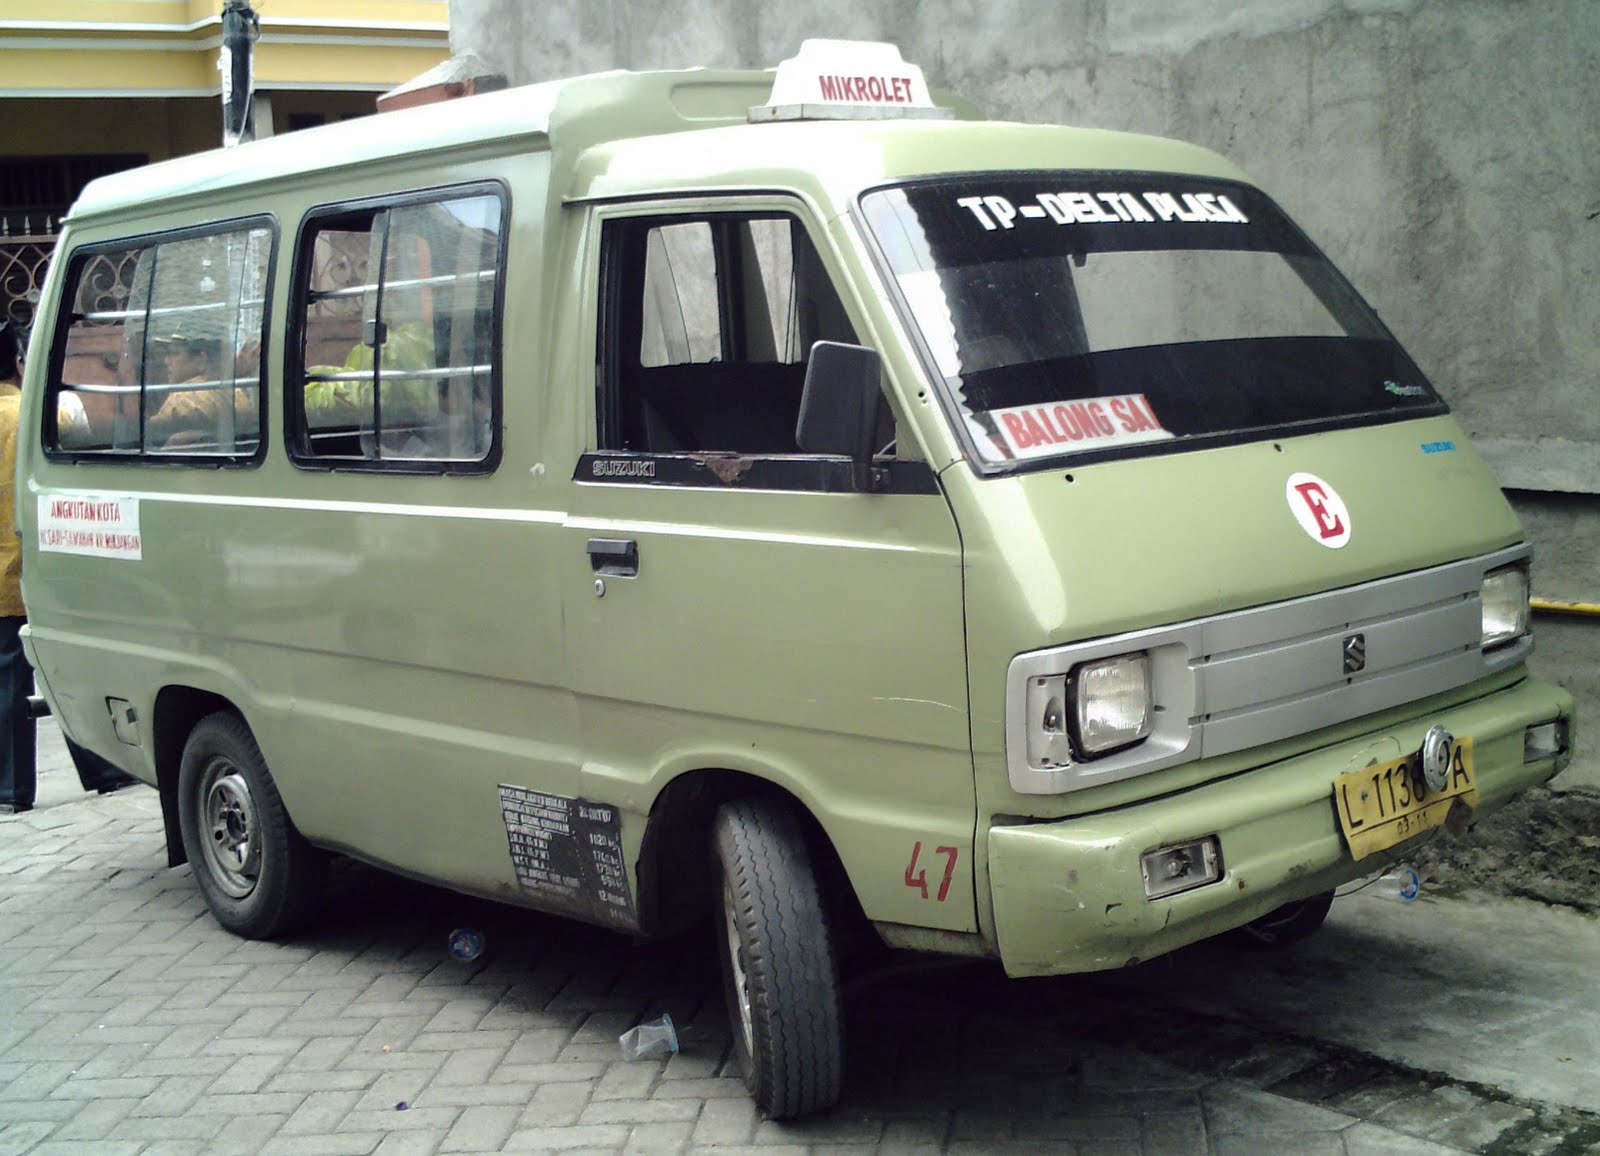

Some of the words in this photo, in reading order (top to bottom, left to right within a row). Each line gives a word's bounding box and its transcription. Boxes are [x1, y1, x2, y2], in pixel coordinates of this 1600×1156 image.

[819, 75, 912, 103] MIKROLET
[1142, 192, 1249, 224] PLASA
[1002, 401, 1116, 450] BALONG
[592, 460, 656, 478] SUZUKI
[51, 500, 96, 522] ANGKUTAN
[96, 502, 121, 522] KOTA
[1294, 481, 1345, 539] E
[1342, 783, 1364, 829] L
[904, 840, 959, 903] 47
